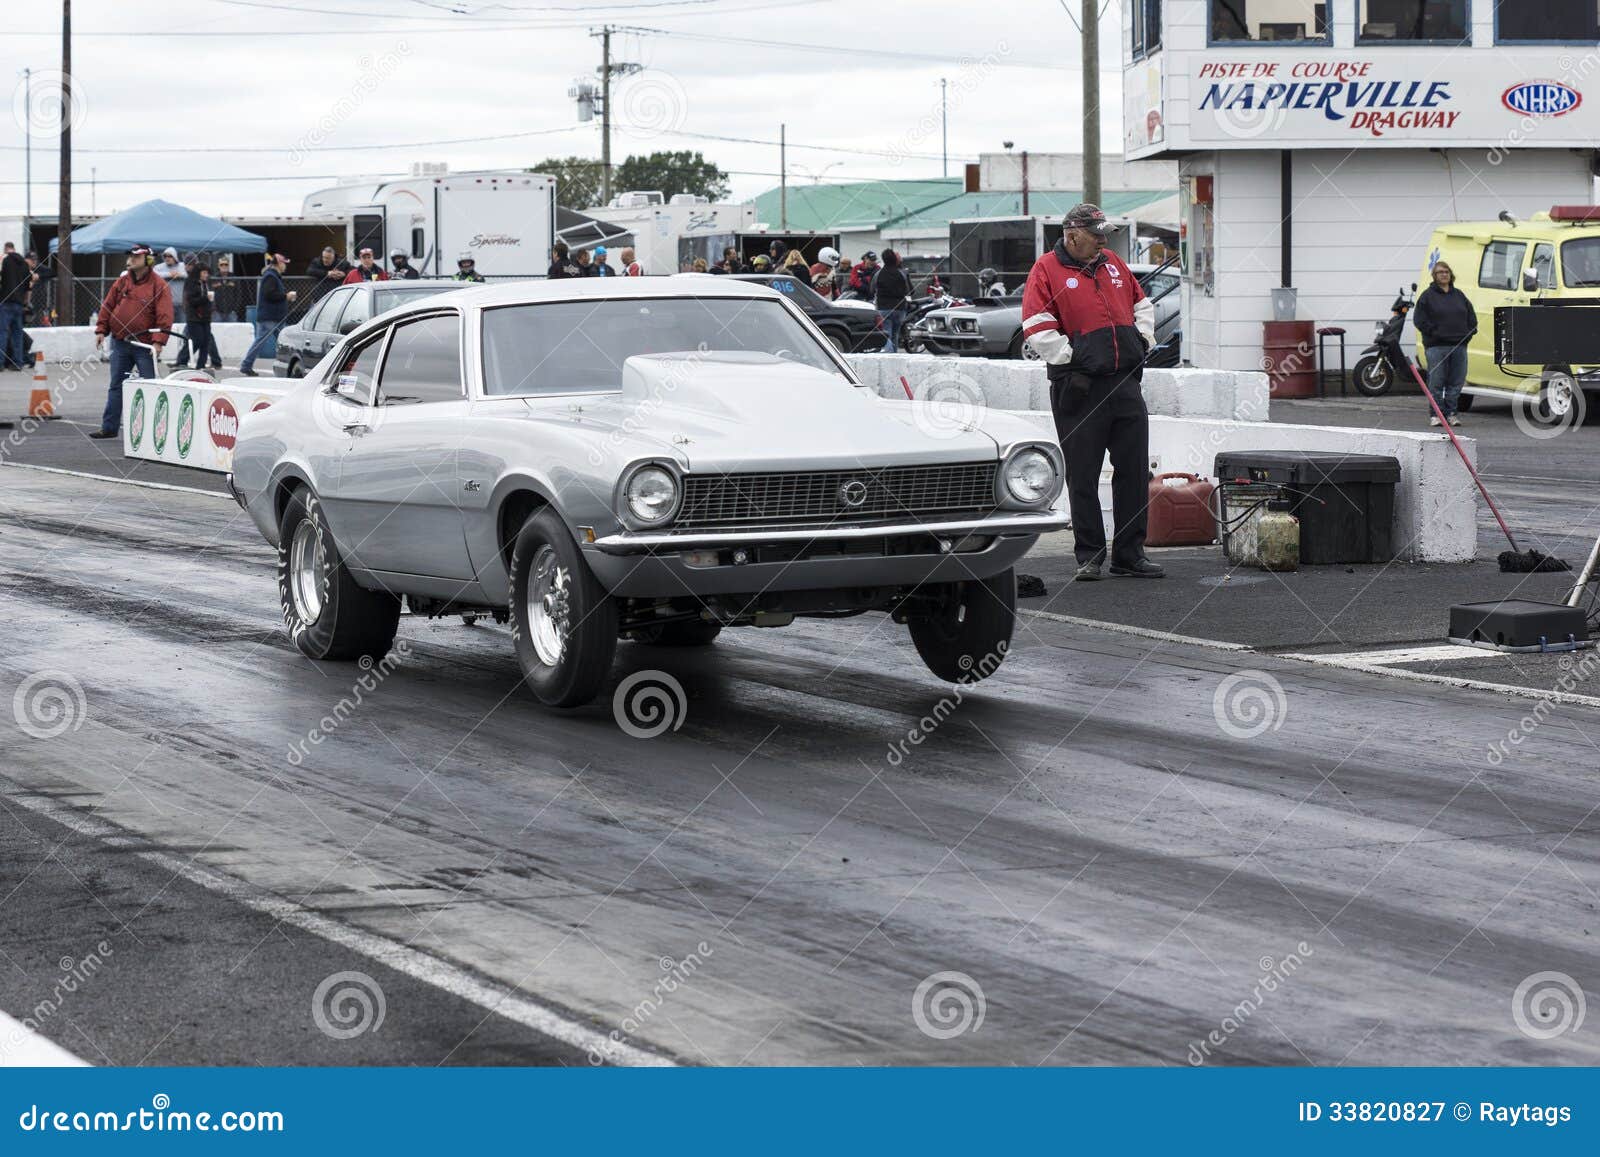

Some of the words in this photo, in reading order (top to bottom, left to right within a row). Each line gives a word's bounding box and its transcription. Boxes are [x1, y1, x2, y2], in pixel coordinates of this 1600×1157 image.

[1199, 63, 1250, 78] PISTE
[1253, 63, 1280, 77] DE
[1292, 62, 1373, 82] COURSE
[1198, 81, 1452, 121] NAPIERVILLE
[1514, 85, 1571, 112] NHRA
[1350, 111, 1461, 136] DRAGWAY
